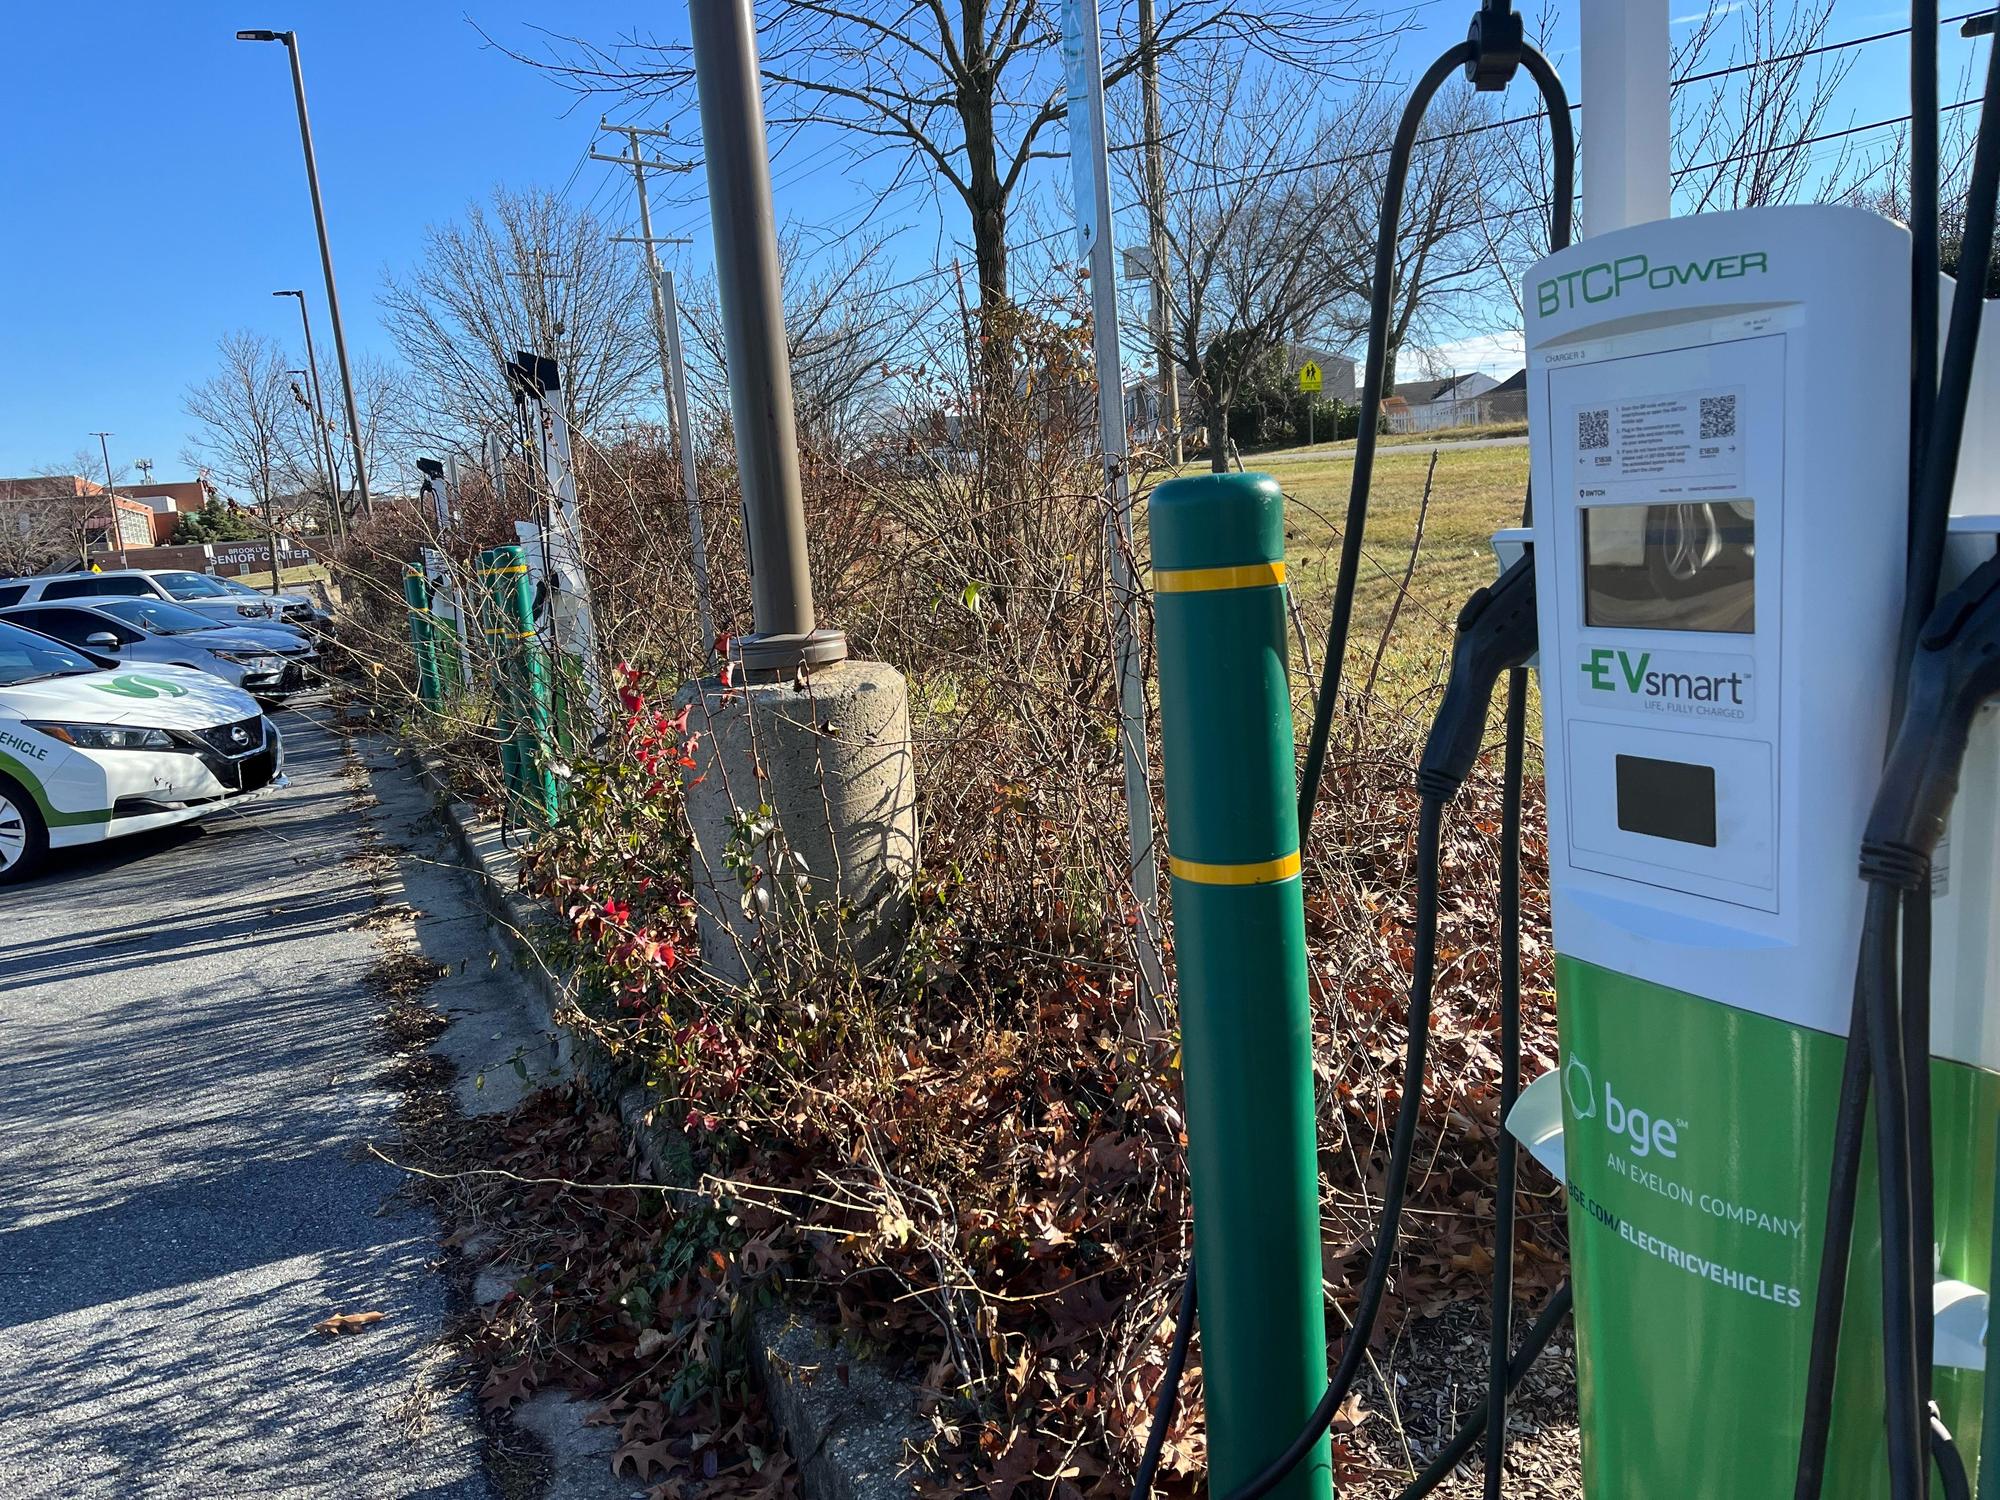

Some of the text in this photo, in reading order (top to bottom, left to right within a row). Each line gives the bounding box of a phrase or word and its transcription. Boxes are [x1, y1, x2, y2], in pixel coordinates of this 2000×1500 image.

[1545, 350, 1586, 364] CHARGER 3
[210, 549, 310, 566] SENIOR CNTER
[228, 546, 270, 555] BROOKLYN
[1644, 701, 1745, 720] LIFE, FULLY CHARGED
[0, 730, 49, 762] EHICLE
[1605, 1081, 1677, 1158] bge
[1607, 1152, 1802, 1239] AN EXELON COMPANY
